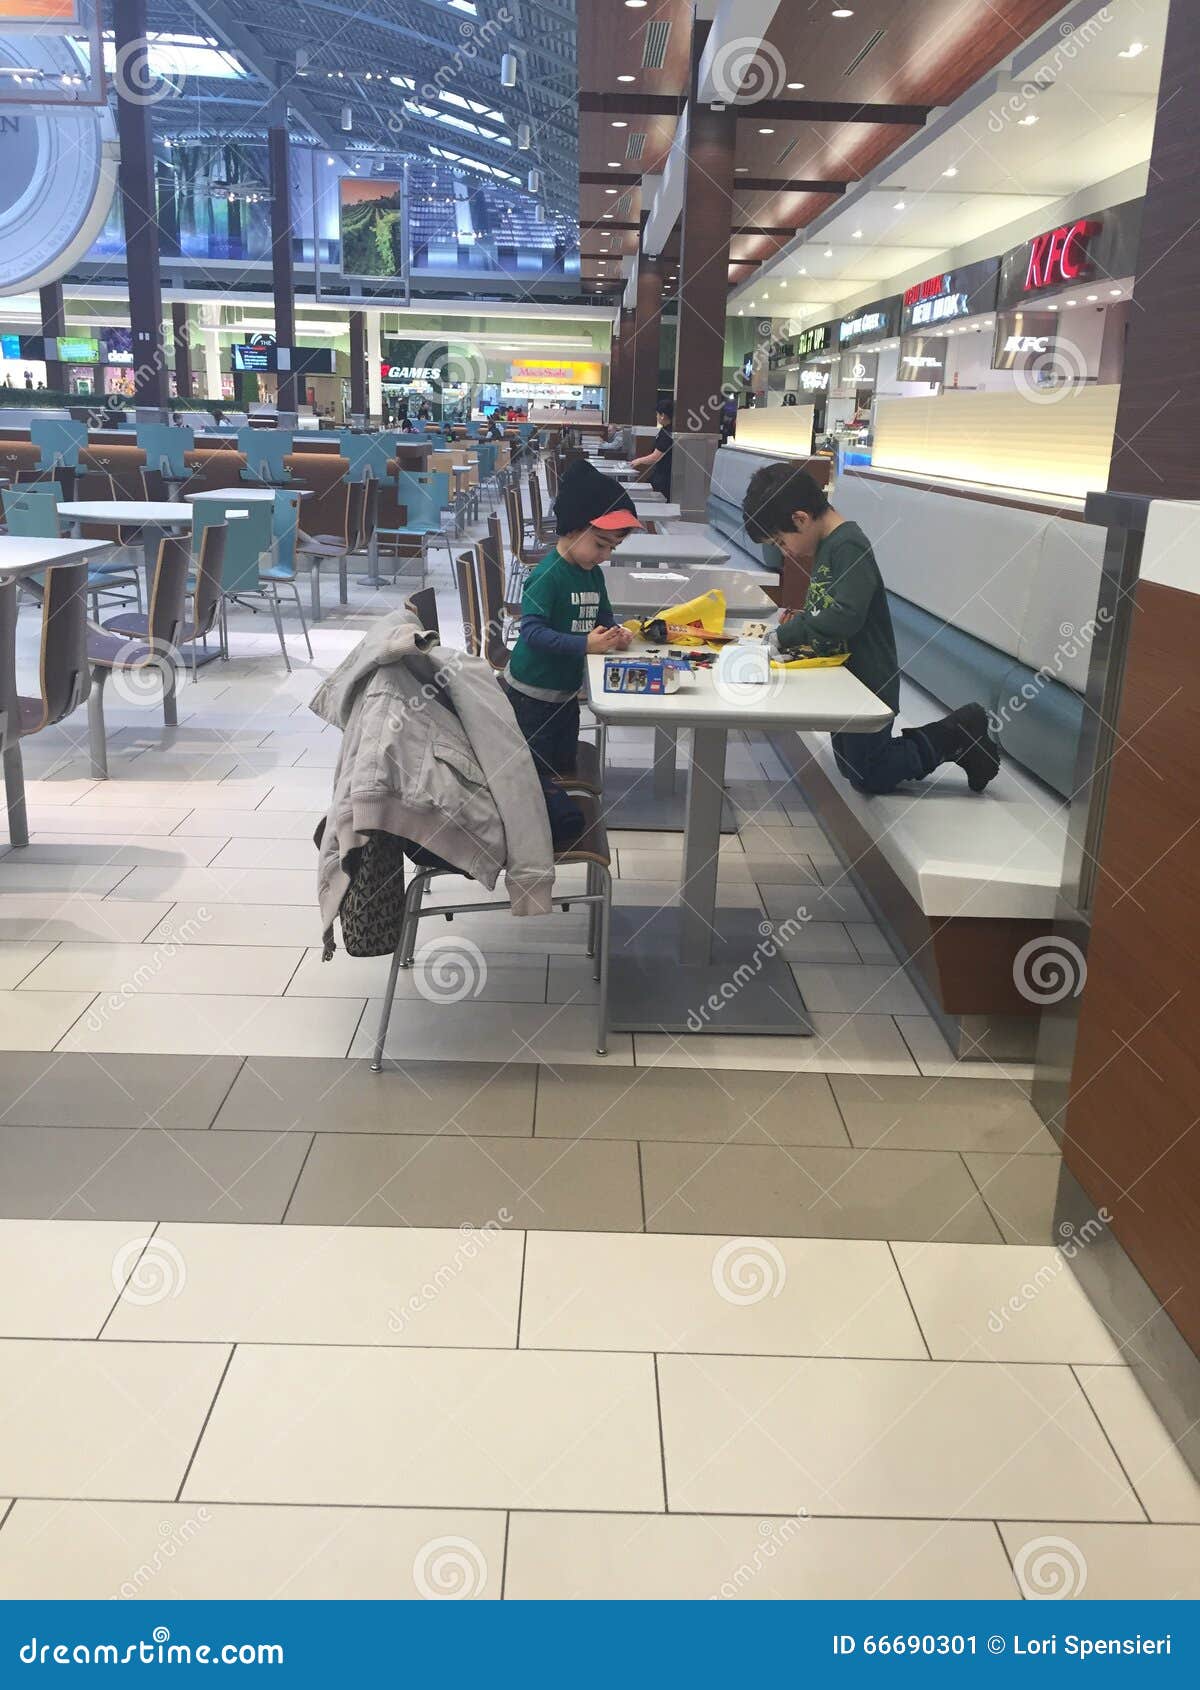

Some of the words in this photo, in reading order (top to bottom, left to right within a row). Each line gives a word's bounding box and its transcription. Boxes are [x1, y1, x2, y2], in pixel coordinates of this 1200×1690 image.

[1024, 220, 1090, 291] KFC
[1003, 336, 1049, 353] KFC
[388, 366, 441, 380] GAMES
